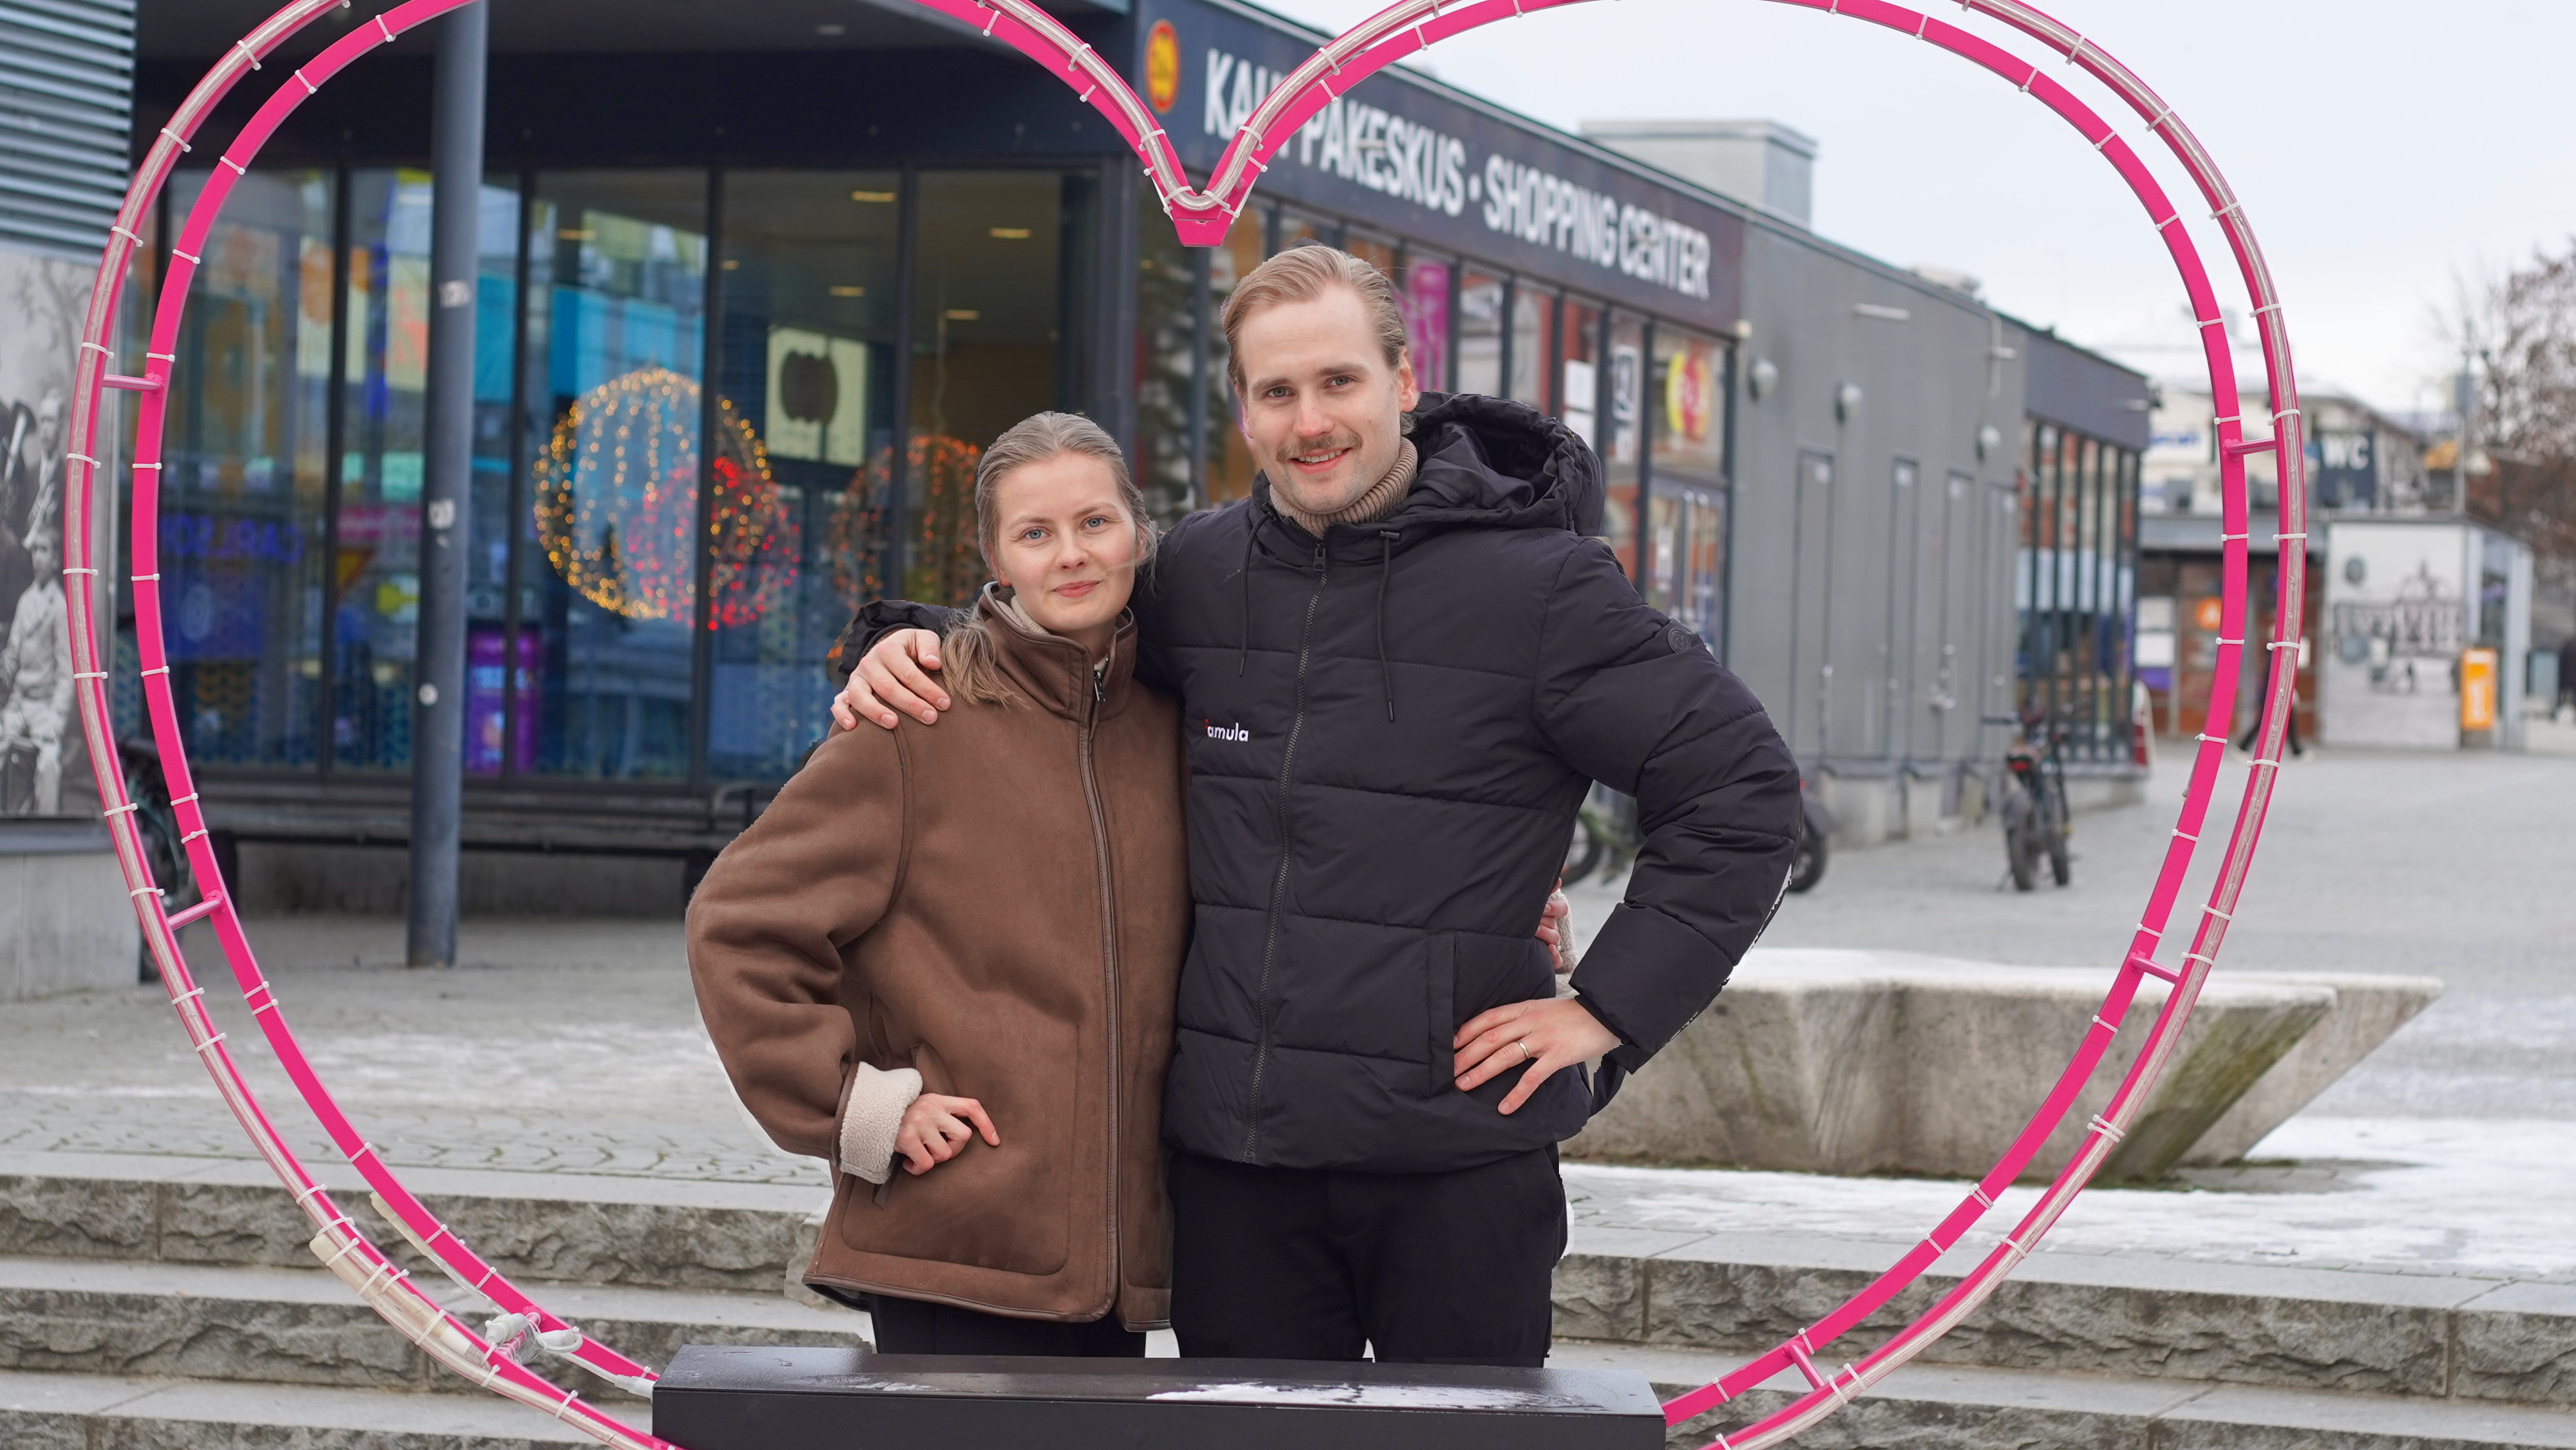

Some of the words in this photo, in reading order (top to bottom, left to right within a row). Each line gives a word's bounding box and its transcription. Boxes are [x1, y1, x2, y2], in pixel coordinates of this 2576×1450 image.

[1203, 47, 1466, 217] KAPAKESKUS
[1483, 152, 1619, 268] SHOPPING
[1619, 202, 1711, 302] CENTER
[2321, 433, 2369, 470] WC
